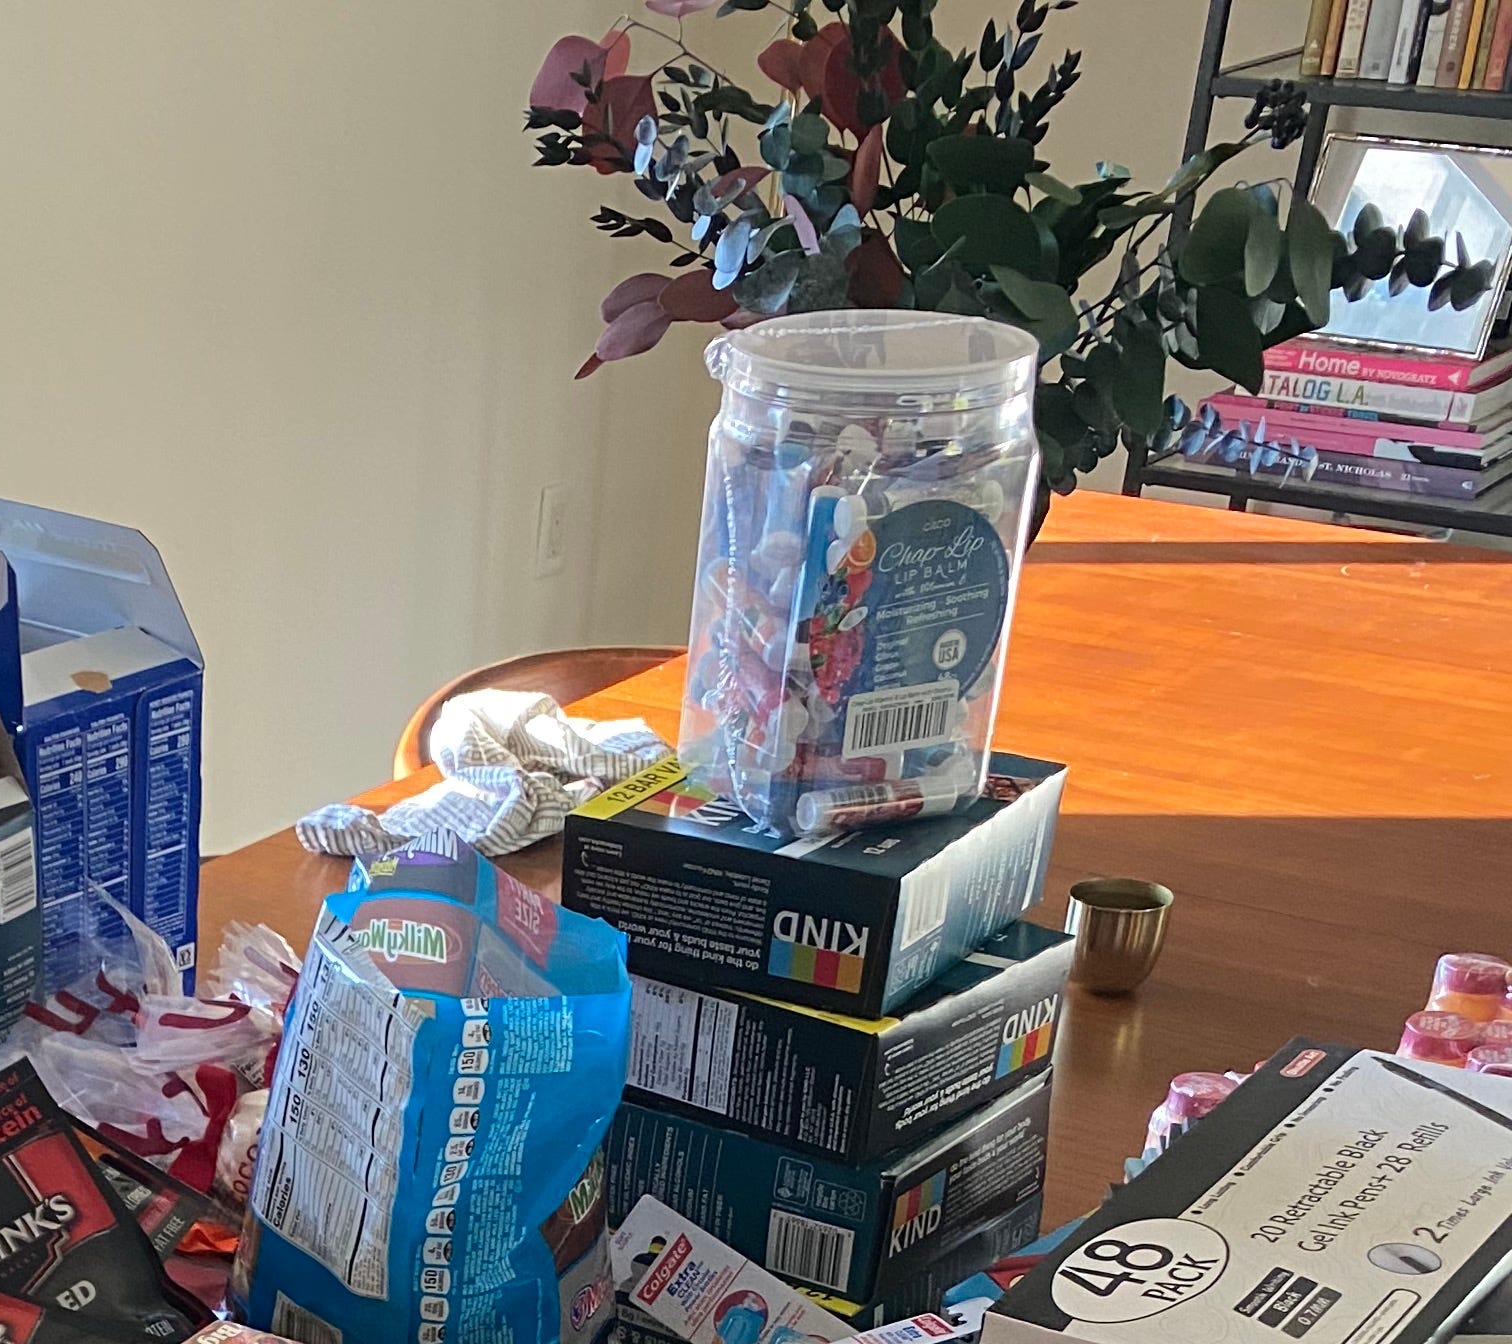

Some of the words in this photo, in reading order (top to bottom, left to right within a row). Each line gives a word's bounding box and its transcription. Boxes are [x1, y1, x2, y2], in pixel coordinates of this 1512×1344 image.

[1298, 352, 1361, 375] Home
[1362, 368, 1376, 376] BY
[1338, 382, 1369, 406] L.A.
[1336, 464, 1392, 479] NICHOLAS
[894, 569, 918, 585] LIP
[923, 559, 968, 579] BALM
[945, 588, 989, 606] Soothing
[938, 649, 959, 664] USA
[626, 771, 663, 798] BAR
[773, 911, 869, 956] KIND
[1003, 993, 1058, 1043] KIND
[297, 1048, 311, 1079] 130
[290, 1095, 302, 1124] 150
[273, 1177, 292, 1228] Calories
[1250, 1225, 1286, 1243] 20
[1270, 1159, 1356, 1226] Retractable
[1337, 1129, 1389, 1159] Black
[1297, 1230, 1337, 1252] Gel
[1376, 1155, 1412, 1173] 28
[1397, 1122, 1450, 1152] Refills
[165, 1215, 186, 1240] FREE
[888, 1203, 942, 1258] KIND
[1413, 1227, 1448, 1244] 2
[1437, 1207, 1469, 1230] Times
[1459, 1185, 1492, 1206] Large
[642, 1241, 687, 1299] Colgate
[667, 1261, 696, 1297] Extra
[1059, 1240, 1173, 1296] 48
[1141, 1253, 1220, 1303] PACK
[1273, 1292, 1302, 1312] Black
